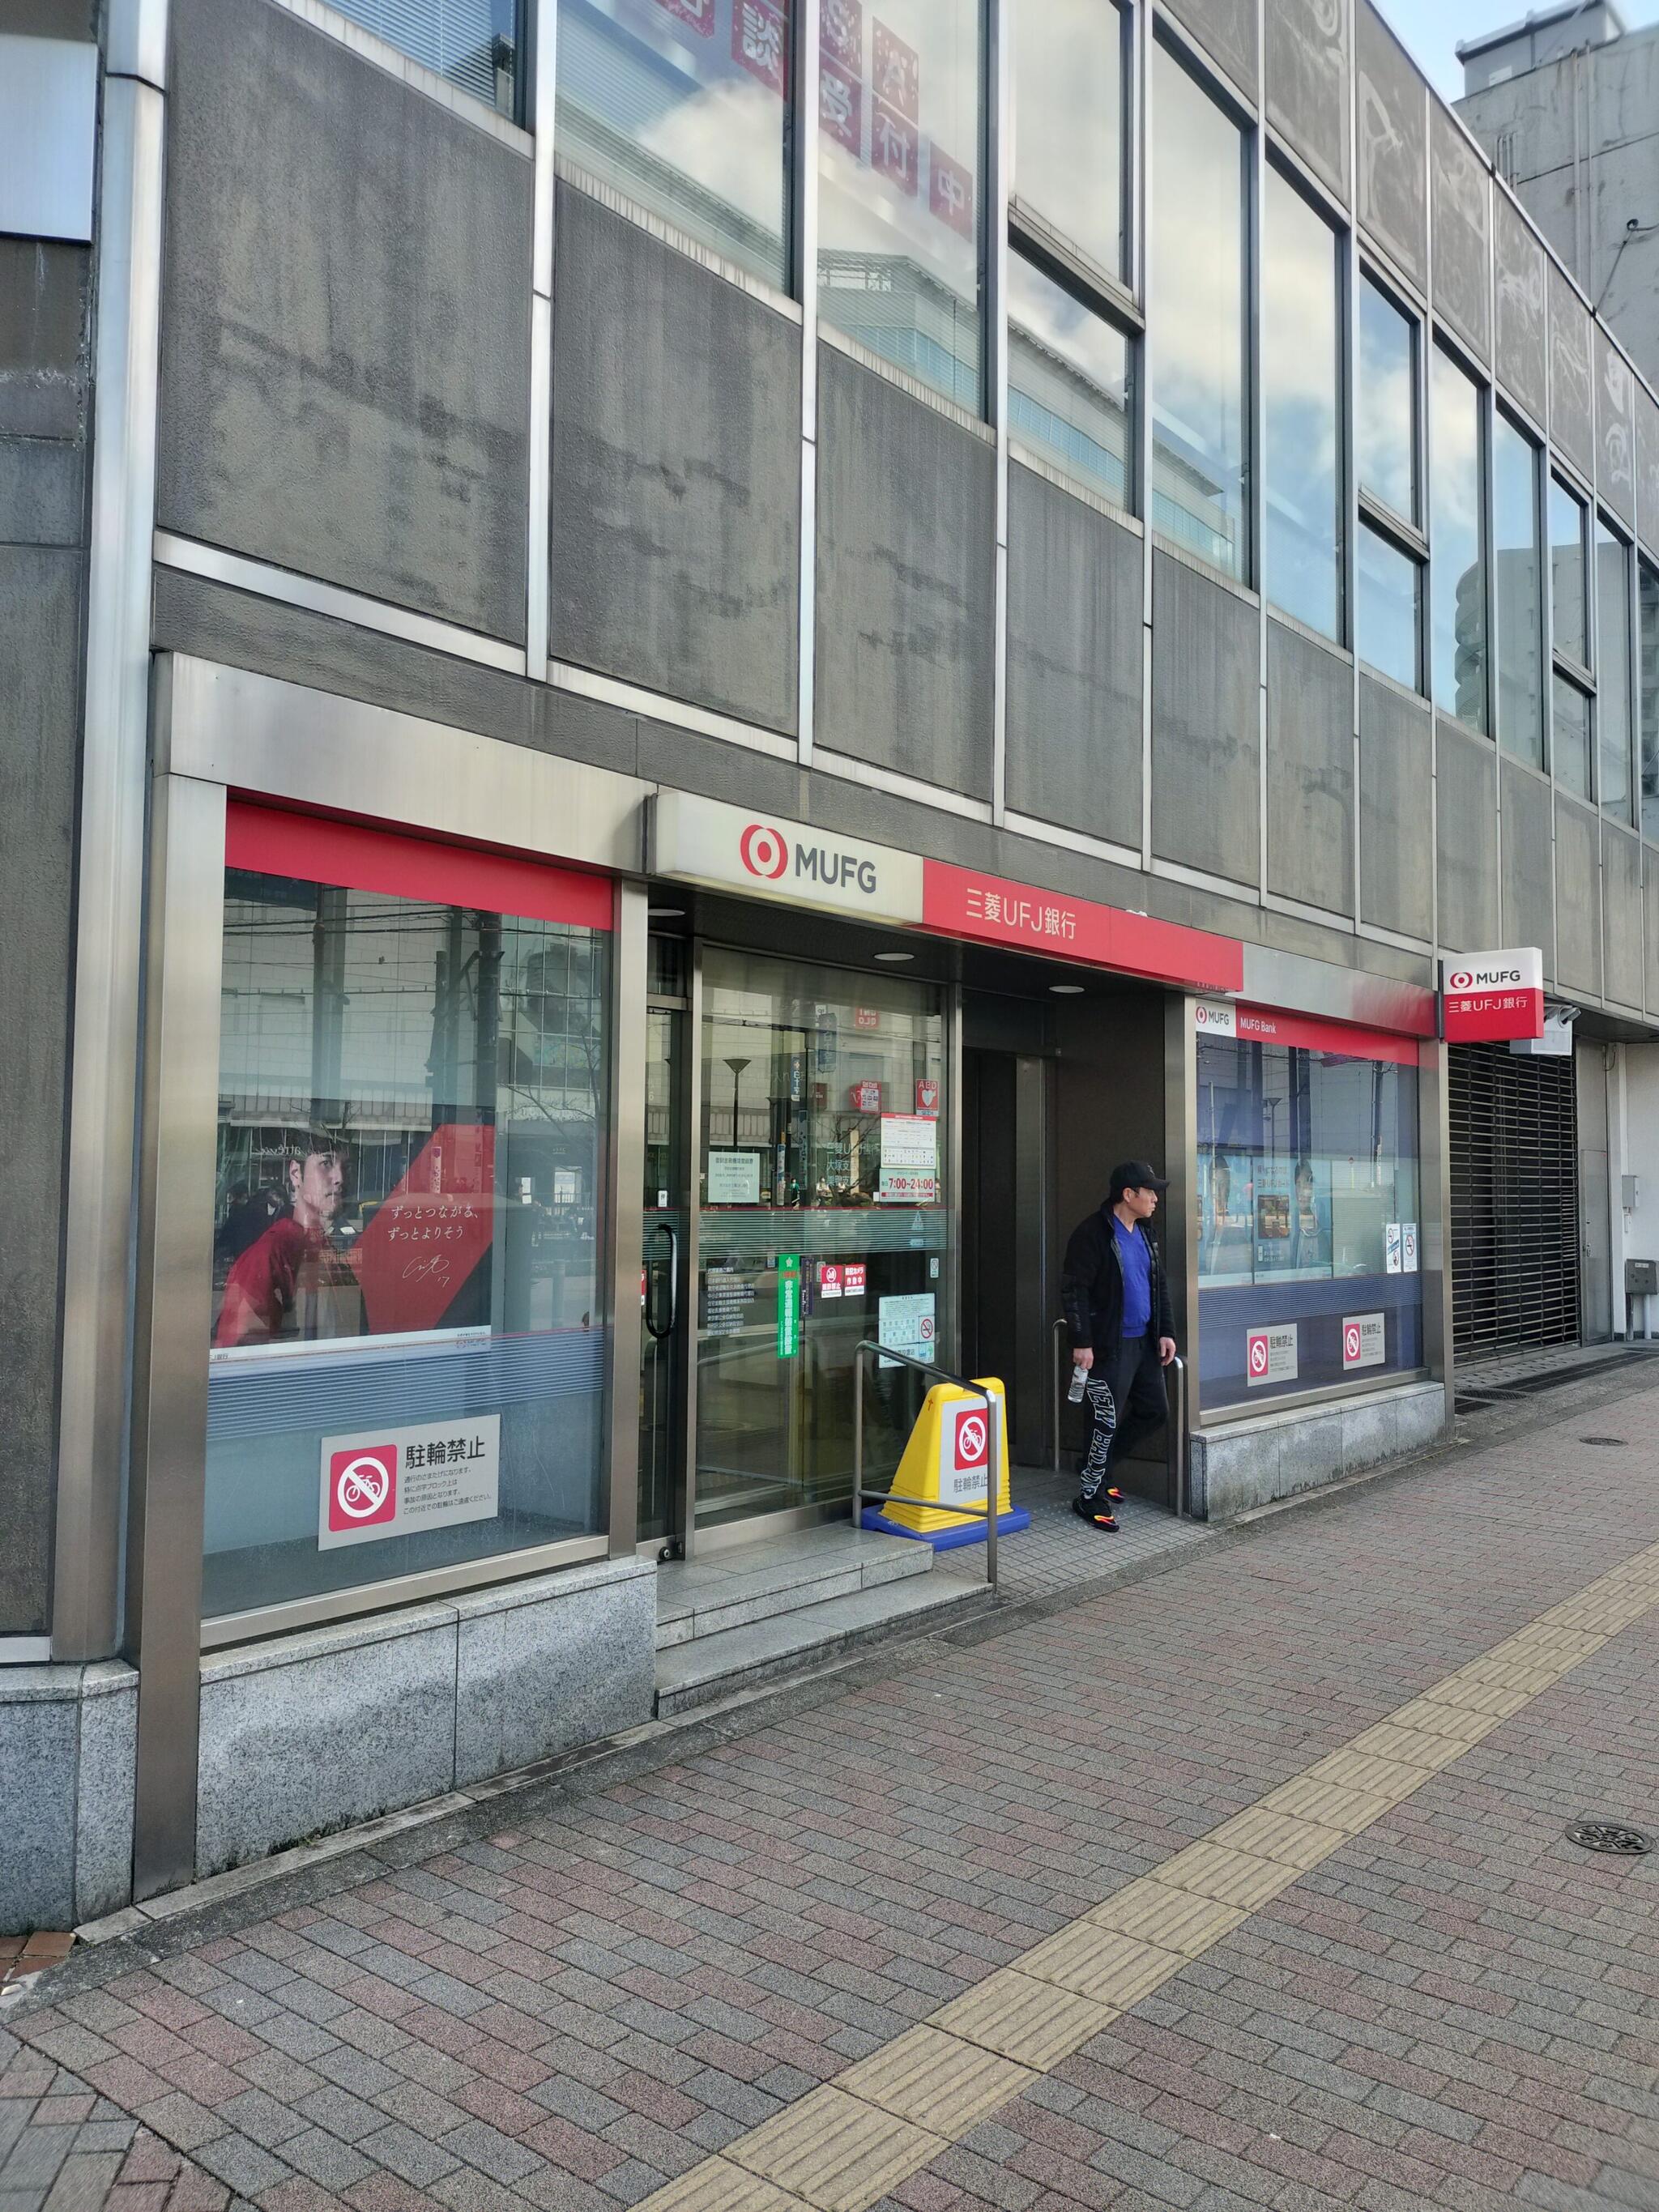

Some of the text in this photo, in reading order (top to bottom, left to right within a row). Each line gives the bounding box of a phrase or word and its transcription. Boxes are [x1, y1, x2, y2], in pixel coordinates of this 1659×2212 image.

[795, 843, 876, 894] MUFG
[965, 887, 1076, 940] 三菱UFJ銀行
[1476, 970, 1520, 985] MUFG
[1448, 996, 1528, 1013] 三菱UFJ銀行
[1208, 1010, 1230, 1025] MUFG
[1240, 1016, 1277, 1034] MUFG Bank
[918, 1080, 937, 1089] AED
[827, 1158, 857, 1172] 大塚支
[387, 1225, 464, 1242] ずっとよりそう
[1086, 1377, 1116, 1429] NEW
[405, 1434, 486, 1469] 駐輪禁止
[953, 1475, 987, 1494] 駐輪禁止
